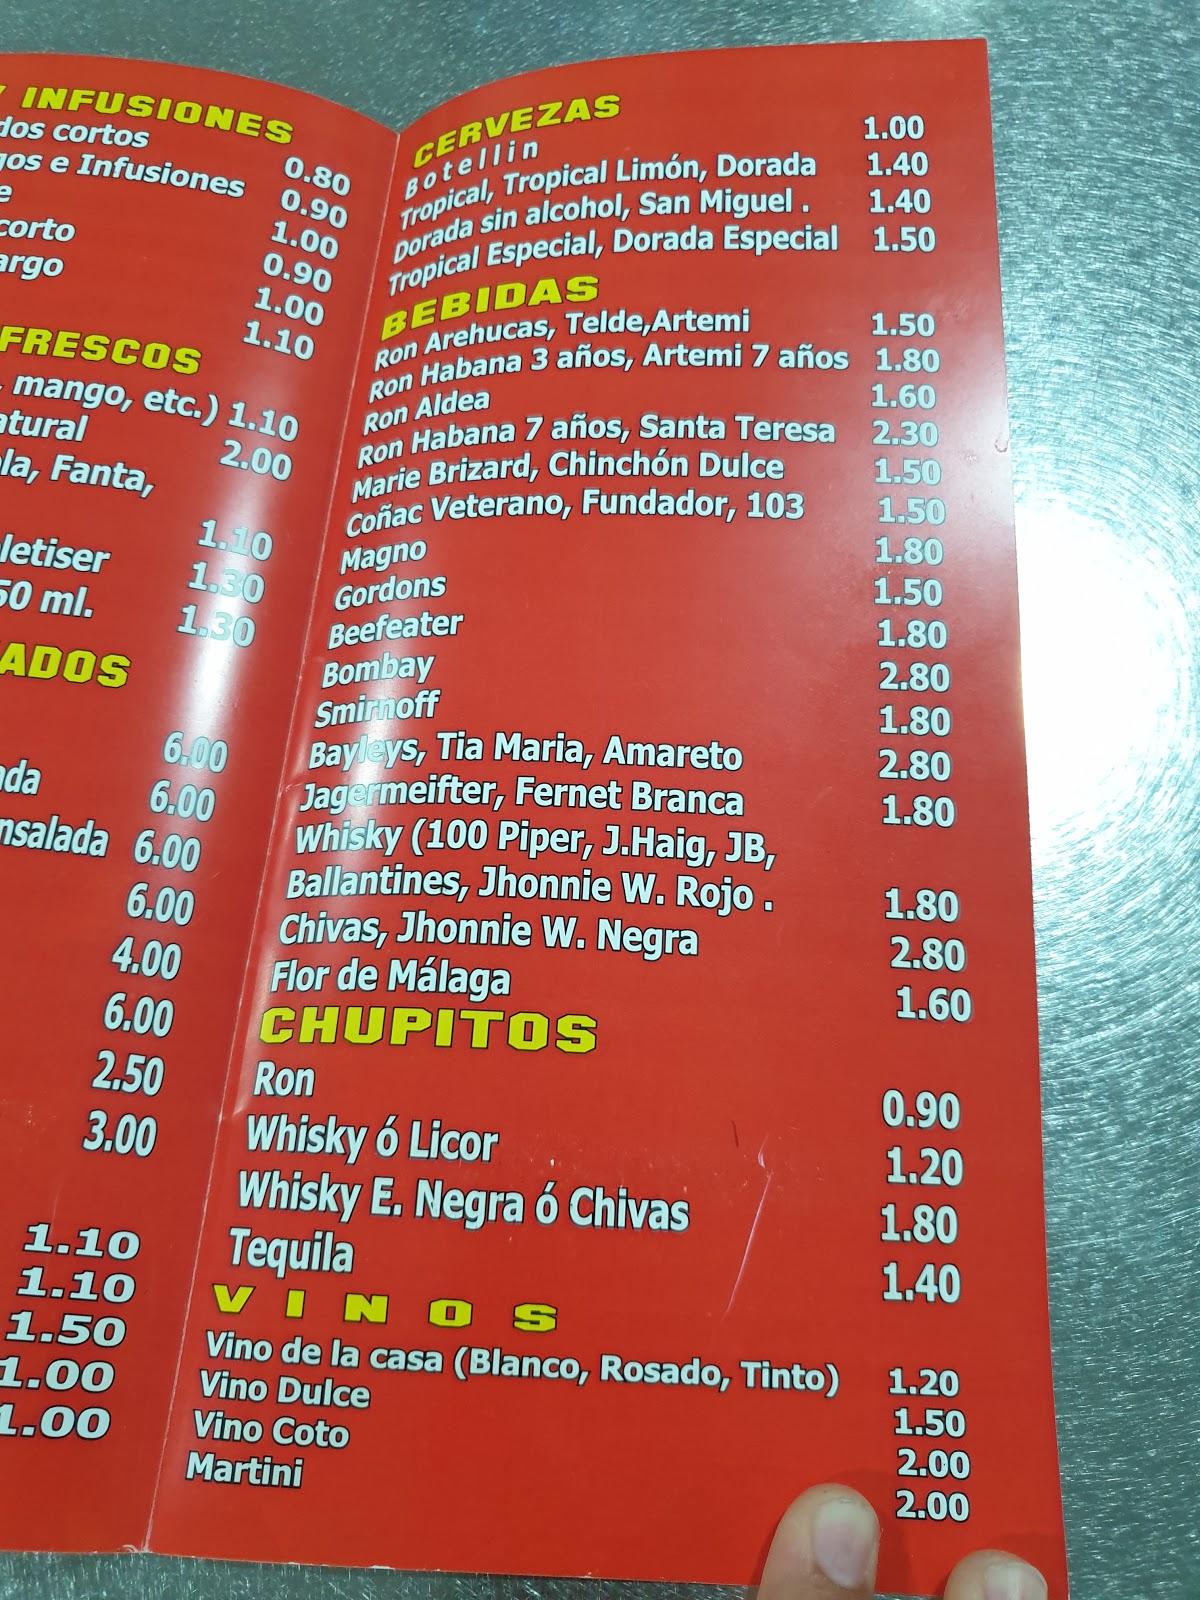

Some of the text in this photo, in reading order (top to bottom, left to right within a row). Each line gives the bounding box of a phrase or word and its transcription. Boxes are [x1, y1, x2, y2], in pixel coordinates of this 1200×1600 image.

[21, 86, 293, 144] INFUSIONES
[413, 94, 620, 168] CERVEZAS
[865, 115, 924, 139] 1.00
[52, 125, 148, 147] cortos
[78, 154, 244, 197] Infusiones
[284, 157, 350, 196] 0.80
[869, 151, 929, 176] 1.40
[281, 189, 347, 228] 0.90
[402, 152, 816, 227] Tropical, Tropical Limón, Dorada
[870, 189, 931, 213] 1.40
[272, 221, 339, 259] 1.00
[394, 189, 792, 262] Dorada sin alcohol, San Miguel
[875, 226, 936, 252] 1.50
[263, 253, 331, 292] 0.90
[390, 224, 838, 295] Tropical Especial, Dorada Especial
[256, 287, 324, 325] 1.00
[380, 275, 598, 341] BEBIDAS
[872, 313, 936, 337] 1.50
[244, 320, 313, 359] 1.10
[375, 342, 417, 369] Ron
[424, 320, 554, 353] Arehucas,
[369, 343, 849, 402] Ron Habana 3 años, Artemi 7 años
[877, 348, 941, 373] 1.80
[13, 376, 218, 426] mango, etc.)
[364, 391, 489, 434] Ron Aldea
[873, 383, 937, 410] 1.60
[229, 402, 298, 441] 1.10
[357, 413, 836, 467] Ron Habana 7 años, Santa Teresa
[873, 419, 941, 448] 2.30
[50, 455, 152, 497] Fanta,
[220, 439, 291, 481] 2.00
[351, 448, 784, 502] Marie Brizard, Chinchón Dulce
[875, 458, 943, 487] 1.50
[347, 488, 804, 537] Coñac Veterano, Fundador, 103
[879, 495, 948, 526] 1.50
[199, 520, 272, 561] 1.10
[341, 540, 426, 572] Magno
[875, 536, 945, 566] 1.80
[189, 562, 264, 603] 1.30
[335, 575, 446, 610] Gordons
[875, 576, 944, 607] 1.50
[178, 605, 255, 648] 1.30
[328, 611, 464, 648] Beefeater
[878, 619, 948, 649] 1.80
[322, 652, 433, 688] Bombay
[879, 661, 950, 692] 2.80
[316, 689, 440, 728] Smirnoff
[880, 705, 951, 737] 1.80
[163, 731, 228, 773] 6.00
[438, 732, 483, 760] Tia
[494, 732, 592, 769] Maria,
[603, 736, 742, 771] Amareto
[879, 749, 951, 781] 2.80
[150, 780, 215, 821] 6.00
[516, 776, 621, 809] Fernet
[632, 781, 744, 816] Branca
[883, 795, 955, 827] 1.80
[134, 830, 200, 872] 6.00
[296, 818, 774, 870] Whisky (100 Piper, J.Haig, JB,
[127, 883, 194, 925] 6.00
[287, 865, 753, 916] Ballantines, Jhonnie W. Rojo
[886, 888, 959, 922] 1.80
[279, 910, 698, 961] Chivas, Jhonnie W. Negra
[892, 936, 965, 972] 2.80
[111, 937, 181, 980] 4.00
[271, 958, 510, 1002] Flor de Málaga
[104, 993, 174, 1036] 6.00
[897, 987, 971, 1022] 1.60
[258, 1006, 597, 1053] CHUPITOS
[93, 1051, 164, 1096] 2.50
[253, 1061, 314, 1096] Ron
[883, 1090, 960, 1129] 0.90
[83, 1110, 156, 1156] 3.00
[248, 1115, 498, 1164] Whisky ó Licor
[887, 1148, 963, 1186] 1.20
[239, 1171, 689, 1232] Whisky E. Negra ó Chivas
[25, 1224, 139, 1260] 1.10
[882, 1205, 958, 1244] 1.80
[230, 1228, 353, 1278] Tequila
[19, 1267, 135, 1303] 1.10
[884, 1263, 960, 1303] 1.40
[6, 1311, 126, 1347] 1.50
[207, 1331, 839, 1398] Vino de la casa (Blanco, Rosado, Tinto)
[890, 1368, 959, 1397] 1.20
[200, 1371, 369, 1408] Vino Dulce
[194, 1410, 349, 1448] Vino Coto
[896, 1408, 965, 1437] 1.50
[187, 1452, 302, 1487] Martini
[898, 1448, 970, 1479] 2.00
[896, 1490, 969, 1521] 2.00
